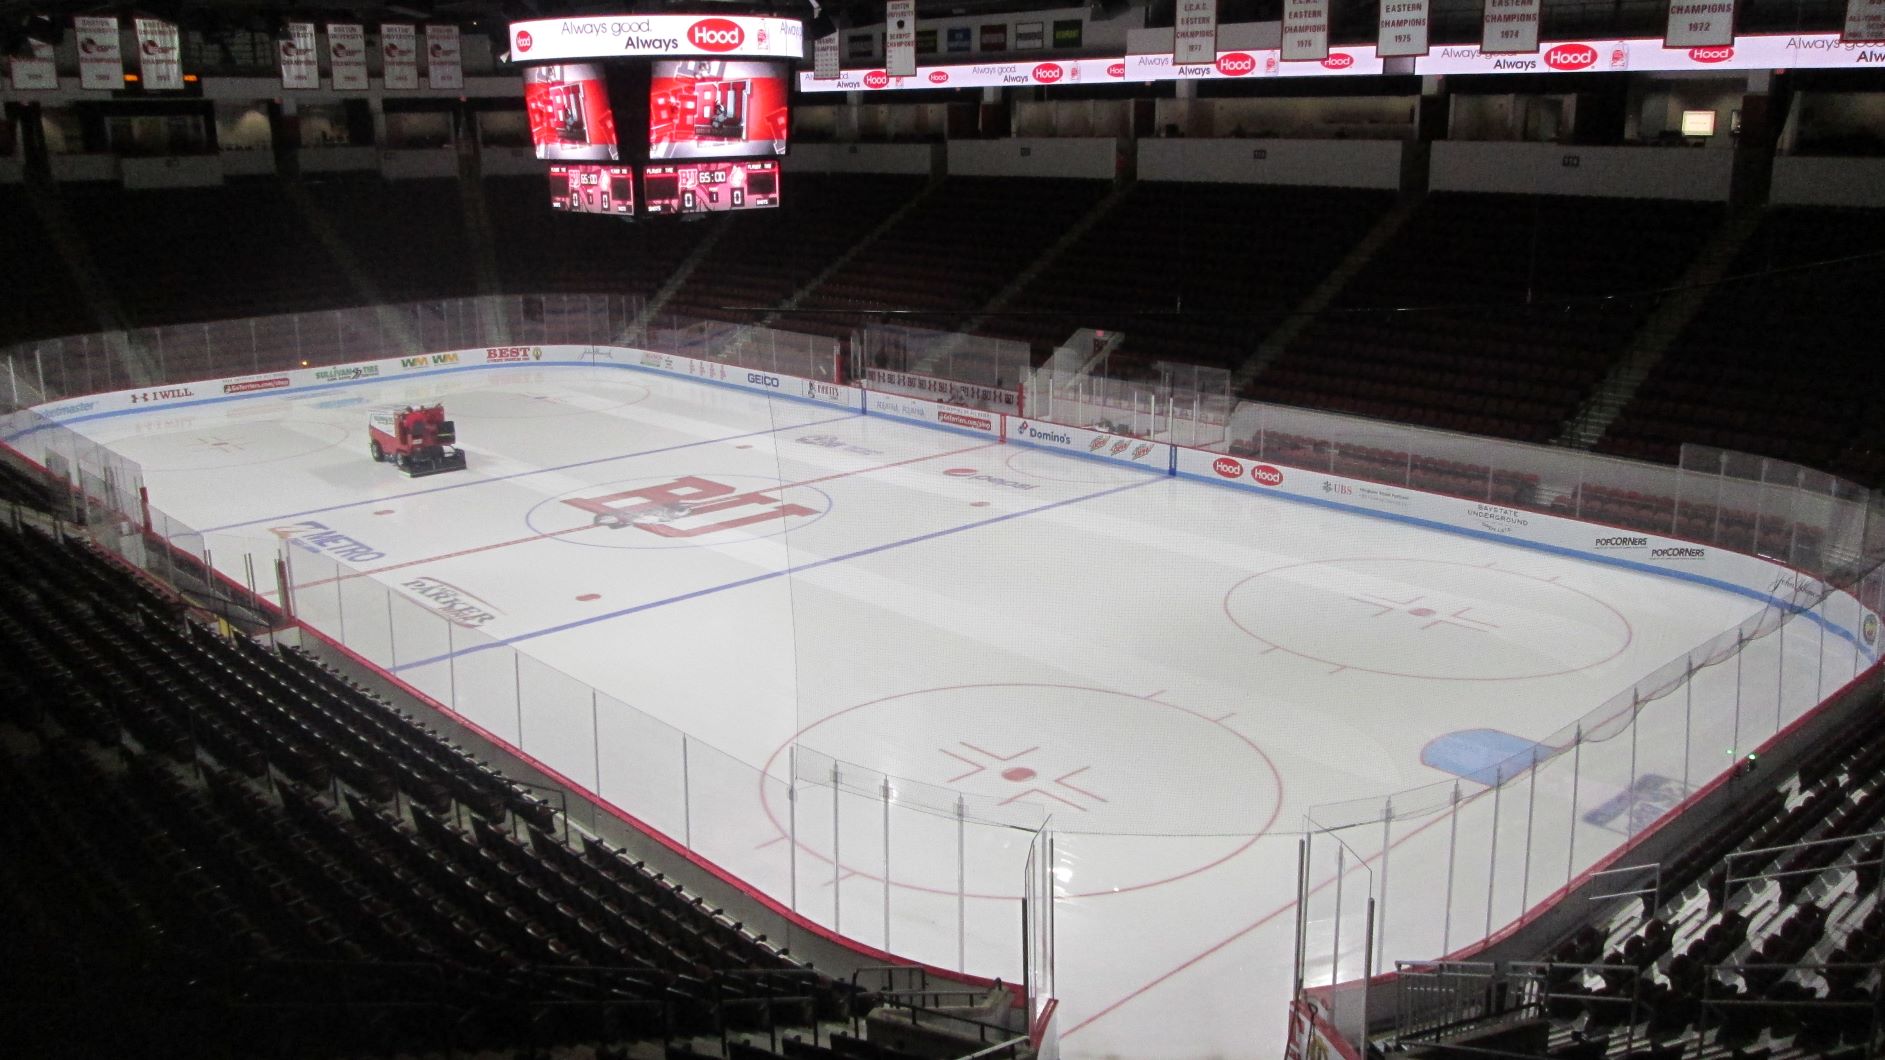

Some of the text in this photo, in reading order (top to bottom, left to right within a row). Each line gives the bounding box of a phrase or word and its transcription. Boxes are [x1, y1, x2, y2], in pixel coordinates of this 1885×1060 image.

[1288, 9, 1322, 19] EASTERN
[1385, 3, 1422, 13] EASTERN
[1670, 3, 1732, 15] CHAMPIONS
[1181, 16, 1211, 25] EASTERN
[1380, 18, 1426, 28] CHAMPIONS
[1484, 13, 1537, 23] CHAMPIONS
[561, 19, 652, 37] Always good.
[1284, 24, 1326, 34] CHAMPIONS
[1688, 22, 1710, 32] 1972
[694, 26, 740, 44] Hood
[1175, 30, 1215, 39] CHAMPIONS
[1394, 34, 1411, 43] 1975
[1500, 30, 1519, 39] 1974
[624, 35, 679, 52] Always
[1786, 37, 1841, 51] Always
[1441, 48, 1482, 59] Always
[1551, 50, 1591, 65] Hood
[1693, 47, 1730, 59] Hood
[1856, 51, 1885, 63] Alw
[1138, 57, 1169, 67] Always
[1220, 58, 1252, 72] Hood
[1325, 56, 1351, 67] Hood
[1493, 59, 1537, 71] Always
[972, 66, 995, 76] Always
[1035, 68, 1061, 80] Hood
[1109, 66, 1125, 75] Hoo
[1178, 65, 1211, 77] Always
[866, 74, 888, 86] Hood
[931, 73, 947, 82] Hood
[1003, 73, 1029, 84] Always
[836, 80, 861, 89] Always
[699, 171, 726, 183] 65:00
[572, 193, 579, 207] 0
[602, 194, 609, 209] 0
[685, 193, 693, 208] 0
[733, 190, 742, 204] 0
[486, 347, 531, 359] BEST
[747, 372, 780, 388] GEICO
[1029, 428, 1071, 445] Domino's
[1216, 461, 1240, 475] Hood
[1254, 469, 1280, 483] Hood
[1333, 483, 1353, 496] UBS
[1478, 504, 1519, 517] BAYSTATE
[1467, 509, 1529, 526] UNDERGROUND
[302, 530, 386, 562] METRO
[1595, 537, 1648, 546] POPCORNERS
[1651, 547, 1705, 558] POPCORNERS
[401, 579, 496, 623] PARKER
